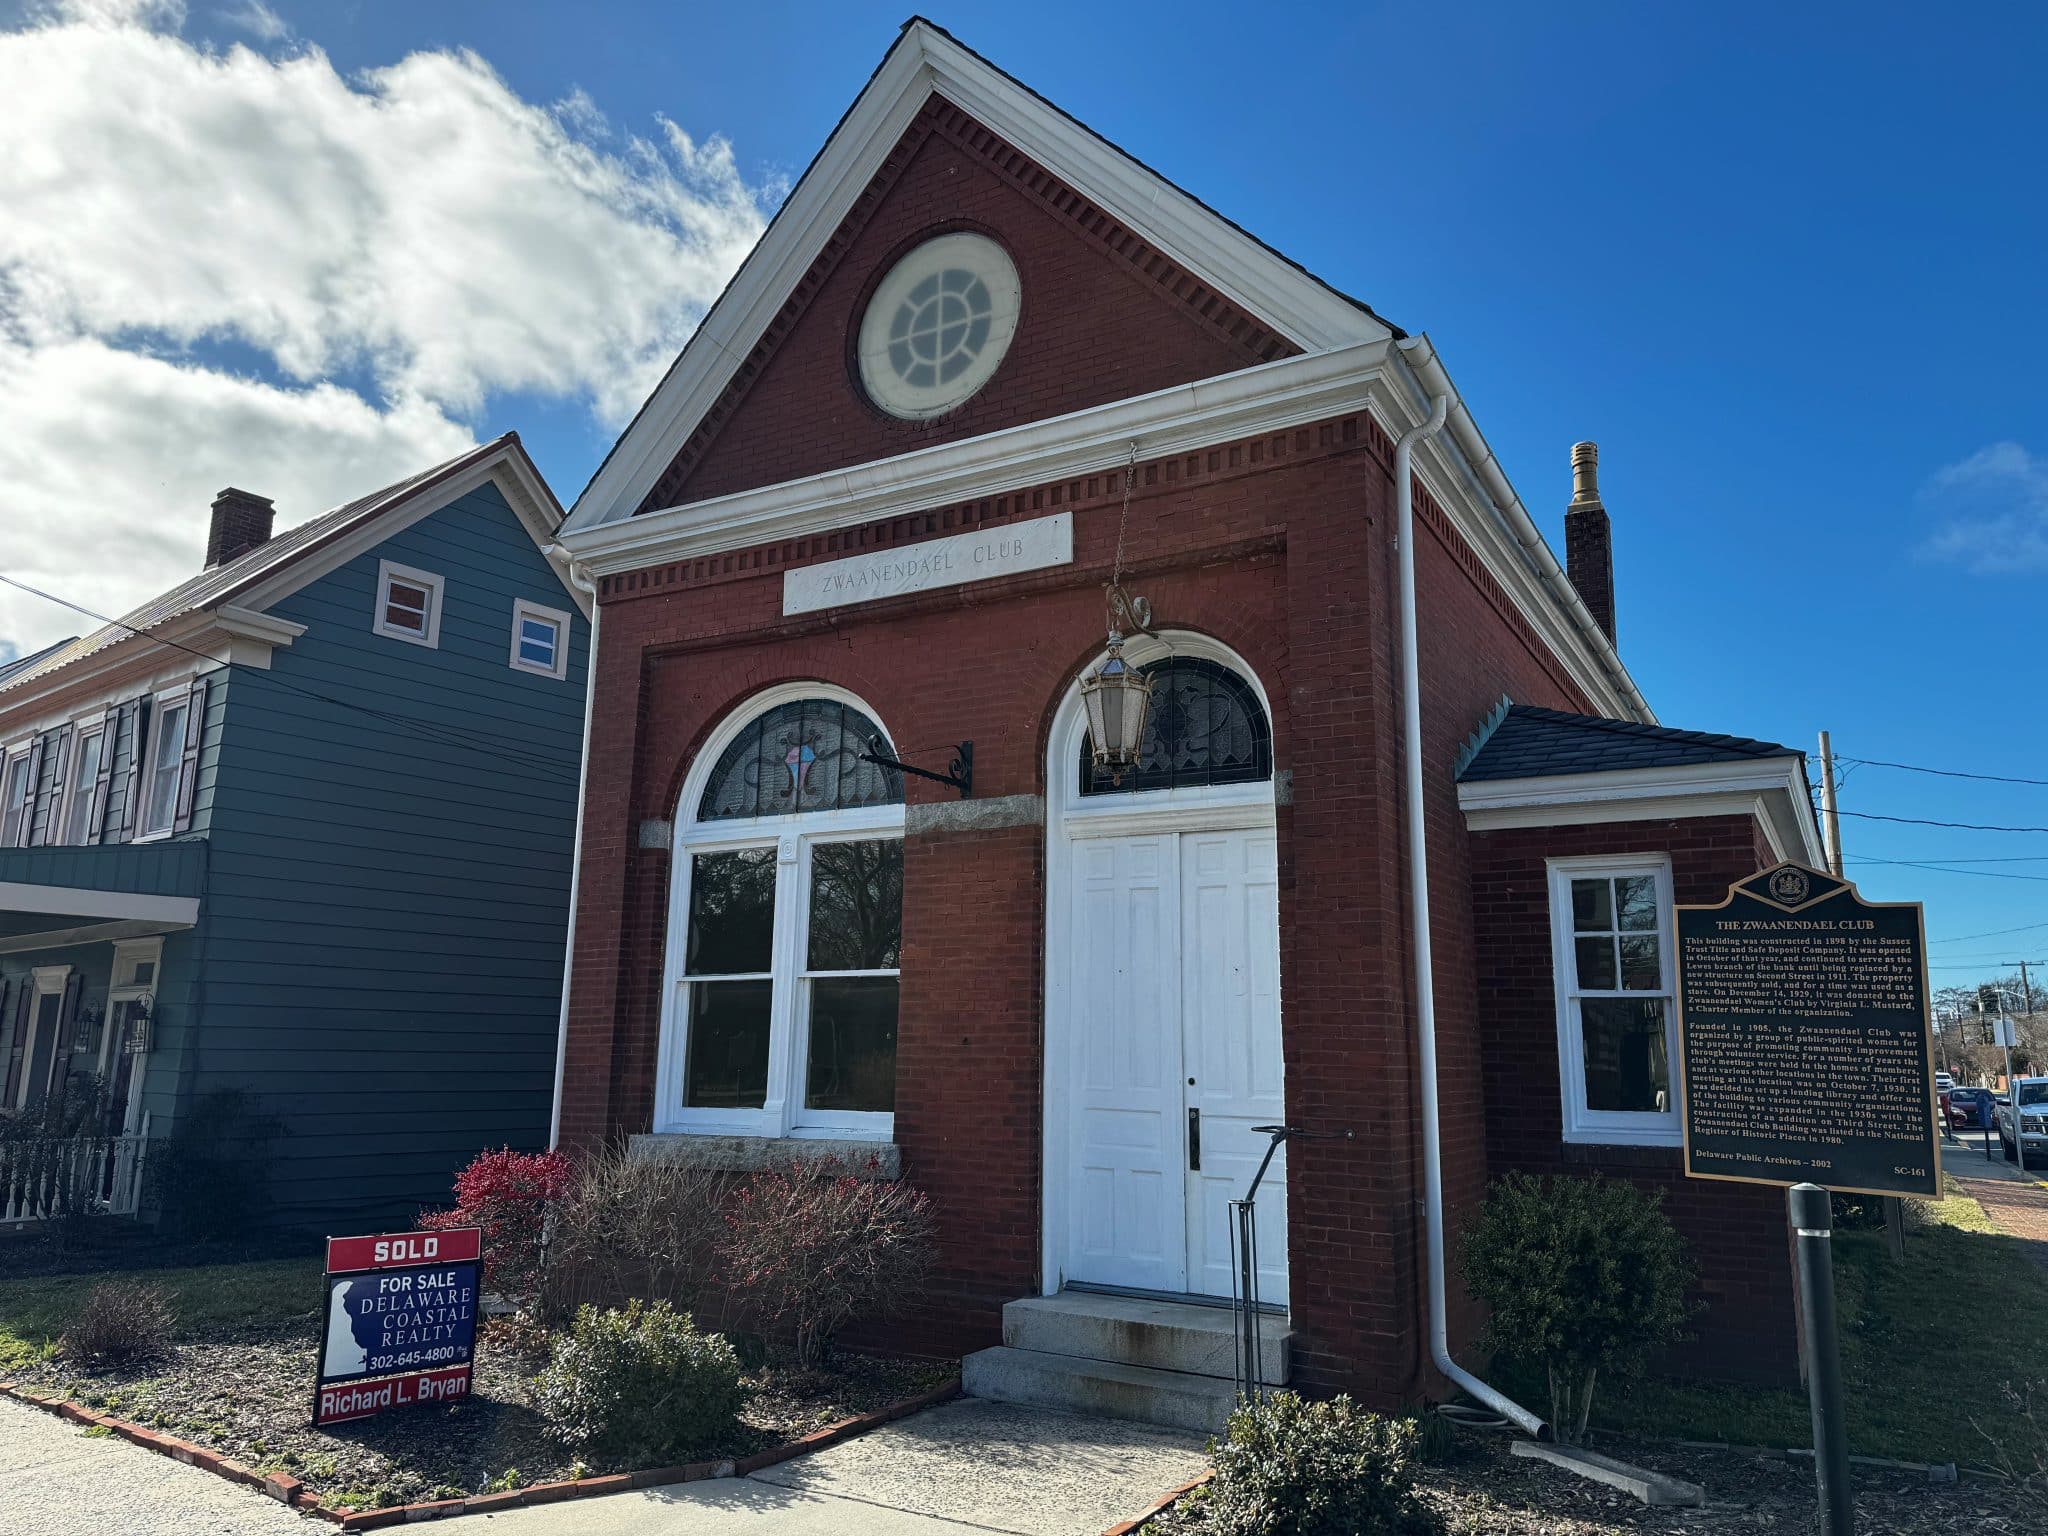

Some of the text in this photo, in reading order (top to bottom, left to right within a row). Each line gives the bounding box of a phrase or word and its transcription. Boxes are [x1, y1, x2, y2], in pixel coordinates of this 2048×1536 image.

[822, 539, 1024, 593] ZWAANENDAEL CLUB
[1716, 920, 1874, 930] THE ZWAANENDAEL CLUB
[1706, 938, 1740, 946] building
[1849, 938, 1860, 946] by
[1768, 947, 1800, 955] Deposit
[1803, 947, 1846, 955] Company.
[1879, 947, 1911, 956] opened
[1823, 965, 1847, 973] being
[1850, 965, 1888, 974] replaced
[1892, 965, 1904, 974] by
[1873, 974, 1913, 983] property
[1774, 990, 1786, 998] 14,
[1790, 991, 1813, 999] 1929,
[1688, 997, 1741, 1005] Zwaanendael
[1744, 998, 1781, 1006] Women's
[1807, 1000, 1818, 1008] by
[1820, 1000, 1857, 1009] Virginia
[1872, 1001, 1915, 1010] Mustard,
[1795, 1008, 1853, 1018] organization.
[1749, 1025, 1771, 1033] 1905,
[1800, 1027, 1860, 1035] Zwaanendael
[1690, 1032, 1730, 1041] organized
[1734, 1033, 1744, 1042] by
[1756, 1035, 1781, 1043] group
[1797, 1035, 1863, 1046] public-spirited
[1691, 1049, 1723, 1058] through
[1726, 1050, 1765, 1058] volunteer
[1767, 1052, 1799, 1060] service.
[1877, 1058, 1901, 1066] years
[1707, 1042, 1740, 1050] purpose
[1756, 1043, 1799, 1053] promoting
[1803, 1045, 1853, 1055] community
[1857, 1047, 1918, 1058] improvement
[1693, 1075, 1725, 1085] meeting
[1759, 1079, 1792, 1087] location
[1831, 1082, 1867, 1090] October
[1871, 1084, 1879, 1092] 7,
[1884, 1085, 1908, 1093] 1930.
[1720, 1094, 1755, 1104] building
[1768, 1097, 1800, 1105] various
[1803, 1099, 1852, 1110] community
[1856, 1102, 1922, 1114] organizations.
[1694, 1110, 1748, 1120] construction
[1779, 1115, 1816, 1124] addition
[1836, 1119, 1863, 1127] Third
[1867, 1121, 1900, 1129] Street.
[1904, 1123, 1923, 1131] The
[1694, 1119, 1748, 1128] Zwaanendael
[1750, 1122, 1770, 1130] Club
[1772, 1124, 1809, 1134] Building
[1830, 1128, 1853, 1136] listed
[1885, 1131, 1924, 1140] National
[1695, 1127, 1729, 1138] Register
[1742, 1131, 1776, 1139] Historic
[1779, 1133, 1806, 1141] Places
[1822, 1136, 1844, 1144] 1980.
[1696, 1150, 1733, 1160] Delaware
[1736, 1153, 1762, 1163] Public
[1764, 1155, 1801, 1166] Archives
[1811, 1159, 1831, 1168] 2002
[1894, 1167, 1925, 1177] SC-161
[374, 1237, 438, 1262] SOLD
[380, 1272, 456, 1293] FOR SALE
[361, 1287, 471, 1314] DELAWARE
[383, 1305, 470, 1329] COASTAL
[381, 1324, 456, 1347] REALTY
[369, 1346, 454, 1370] 302-645-4800
[321, 1376, 466, 1417] Richard L. Bryan
